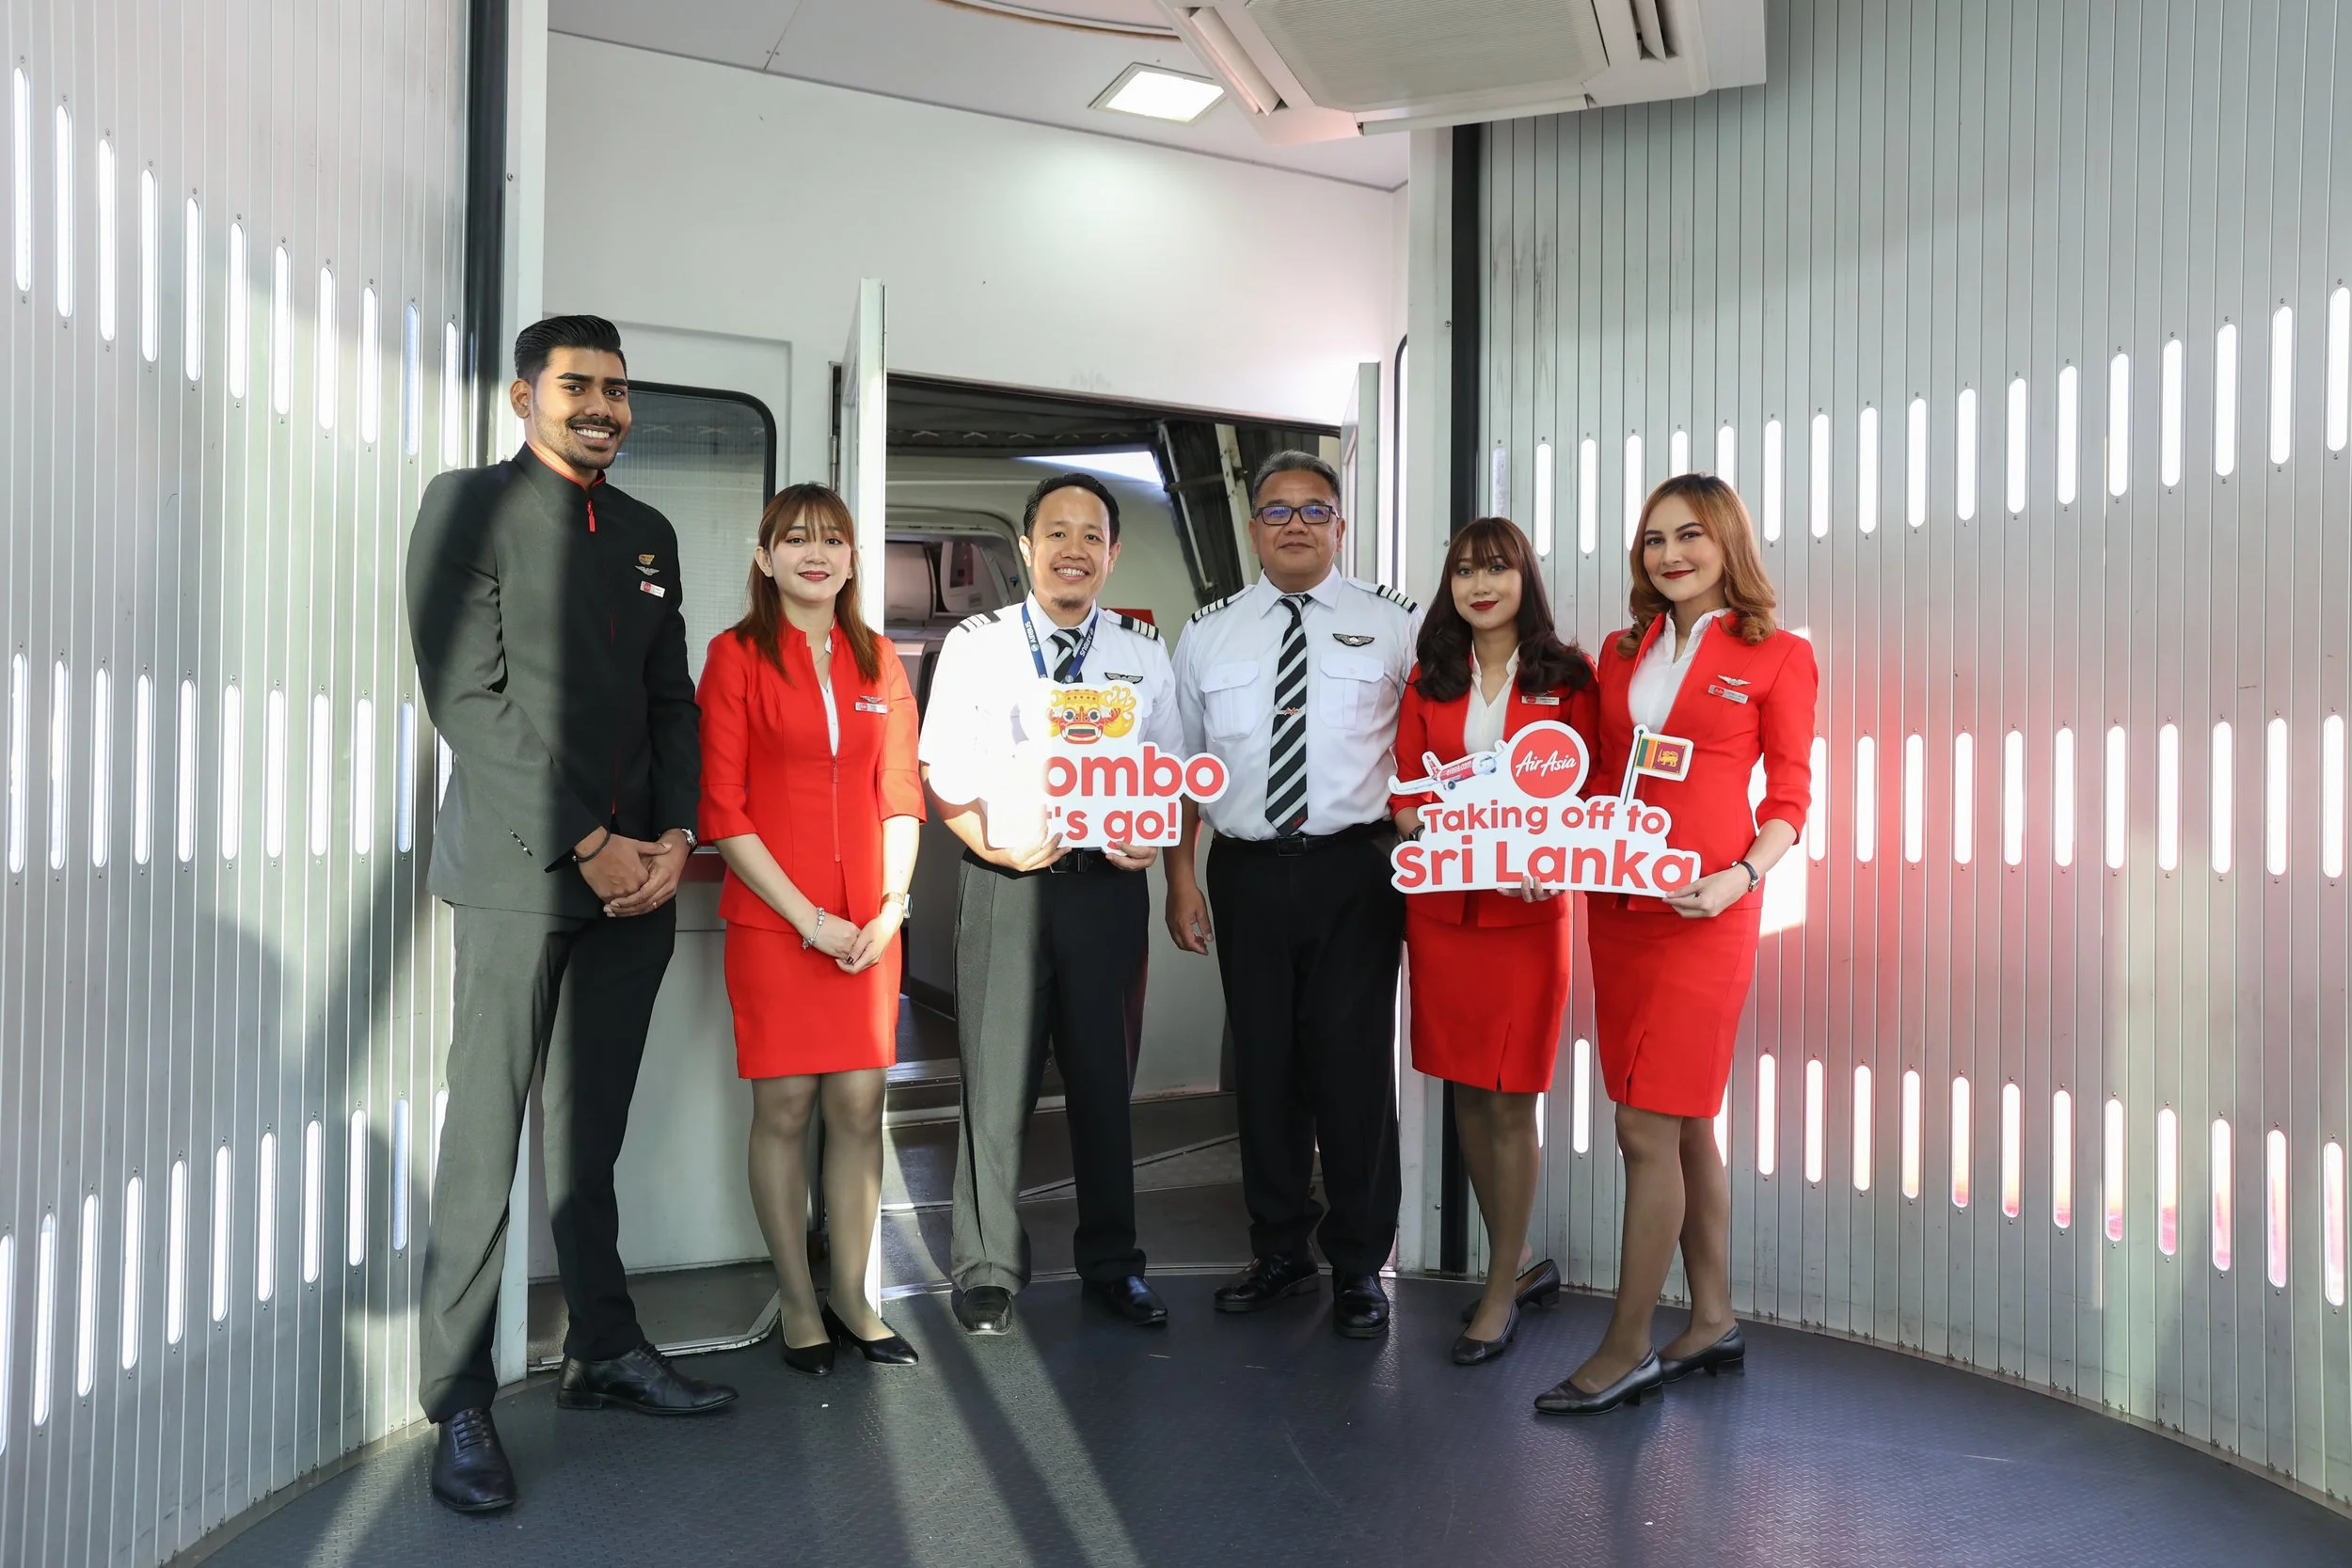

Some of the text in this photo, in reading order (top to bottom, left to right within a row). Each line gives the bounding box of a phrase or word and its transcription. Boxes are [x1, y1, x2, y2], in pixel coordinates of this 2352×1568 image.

[1025, 621, 1037, 643] AIRBUS
[1079, 634, 1092, 657] AIRBUS
[1041, 746, 1224, 797] ombo
[1104, 802, 1176, 849] go!
[1423, 800, 1665, 834] Taking off to
[1396, 835, 1694, 892] Sri Lanka
